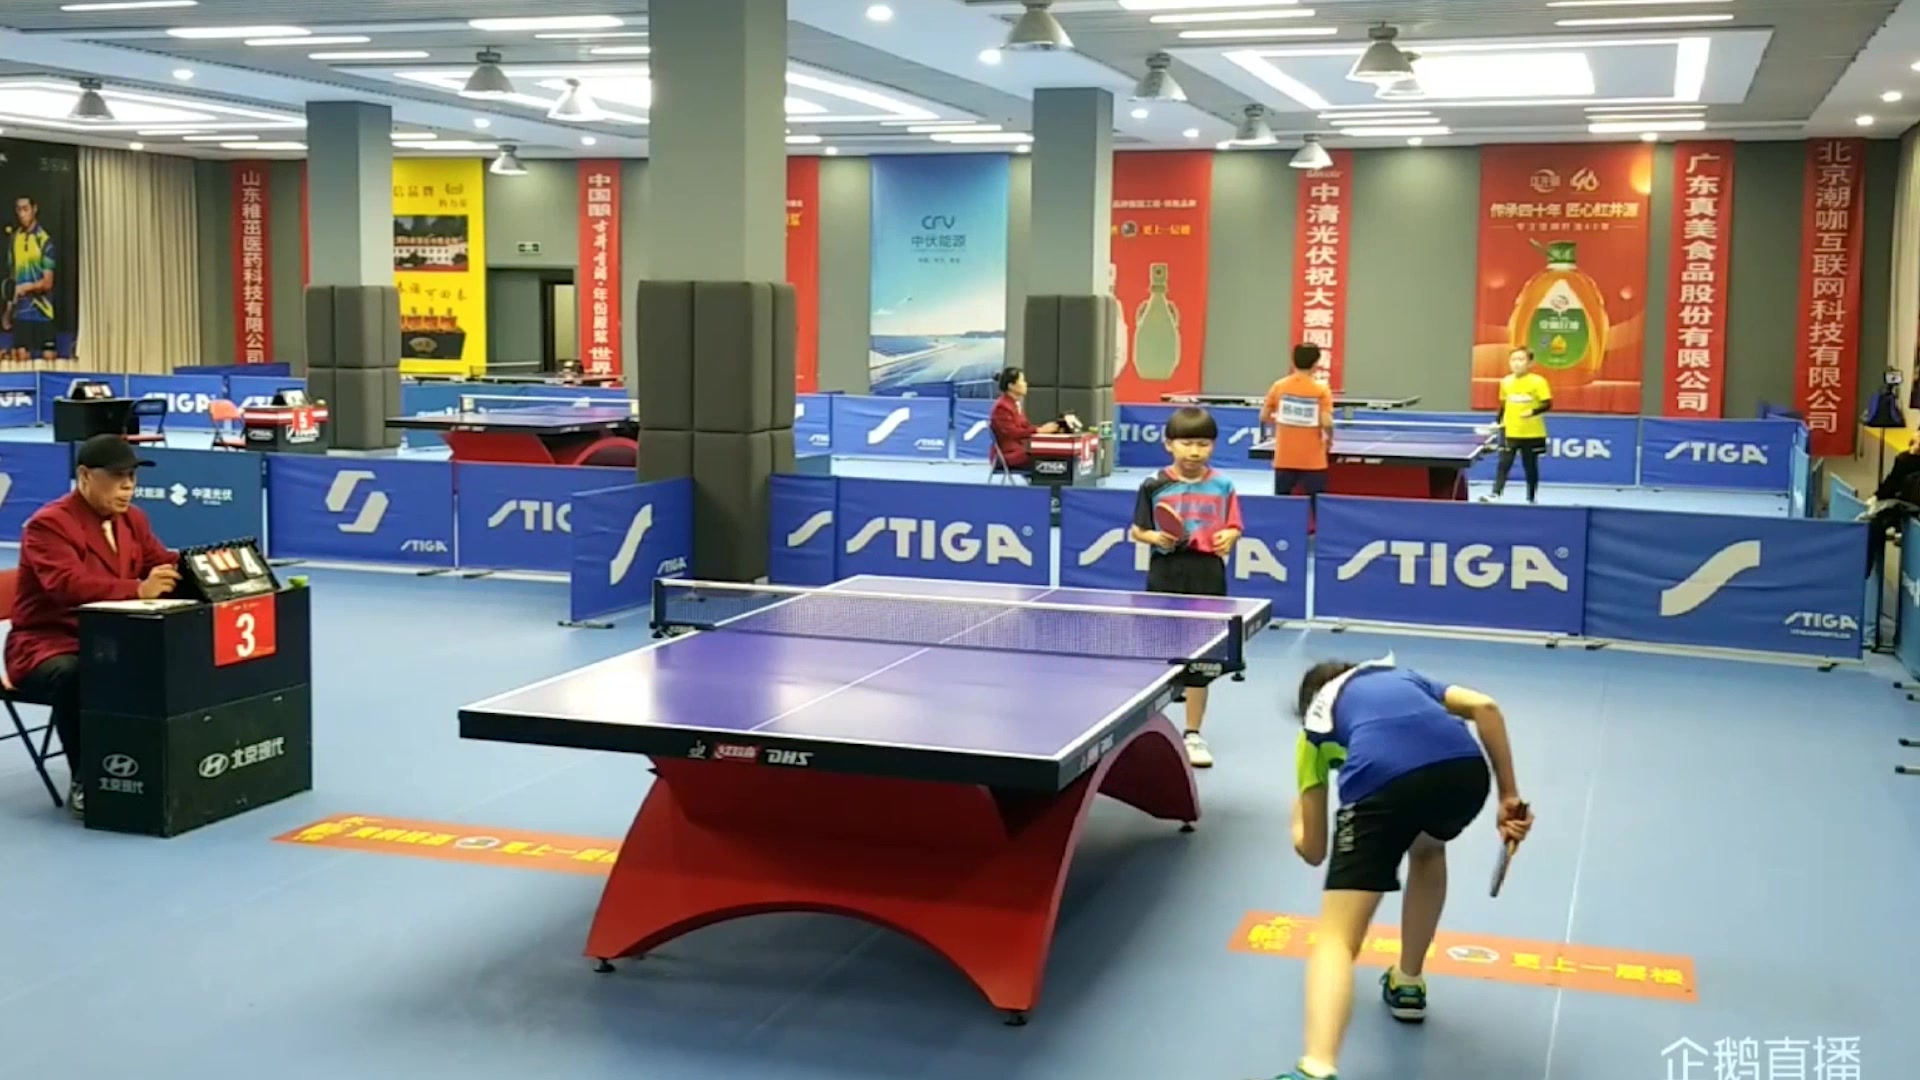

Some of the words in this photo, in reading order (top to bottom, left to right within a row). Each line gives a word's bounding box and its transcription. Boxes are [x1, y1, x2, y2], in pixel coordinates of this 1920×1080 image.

[1490, 203, 1561, 218] 传承四十年
[911, 234, 966, 247] 中伏能源
[1676, 153, 1720, 412] 广东真美食品股份有限公司
[1806, 141, 1851, 433] 北京潮咖互联网科技有限公司
[298, 411, 308, 428] 5
[1664, 441, 1768, 464] STIGA
[401, 539, 448, 552] STIGA
[846, 516, 1033, 567] STIGA
[657, 556, 688, 575] STIGA
[1337, 539, 1568, 592] STIGA
[1784, 611, 1858, 630] STIGA
[235, 612, 255, 658] 3
[231, 737, 284, 769] 北京现代
[766, 749, 814, 766] DHS
[99, 777, 144, 795] 北京现代
[1511, 951, 1685, 986] 更上一层楼
